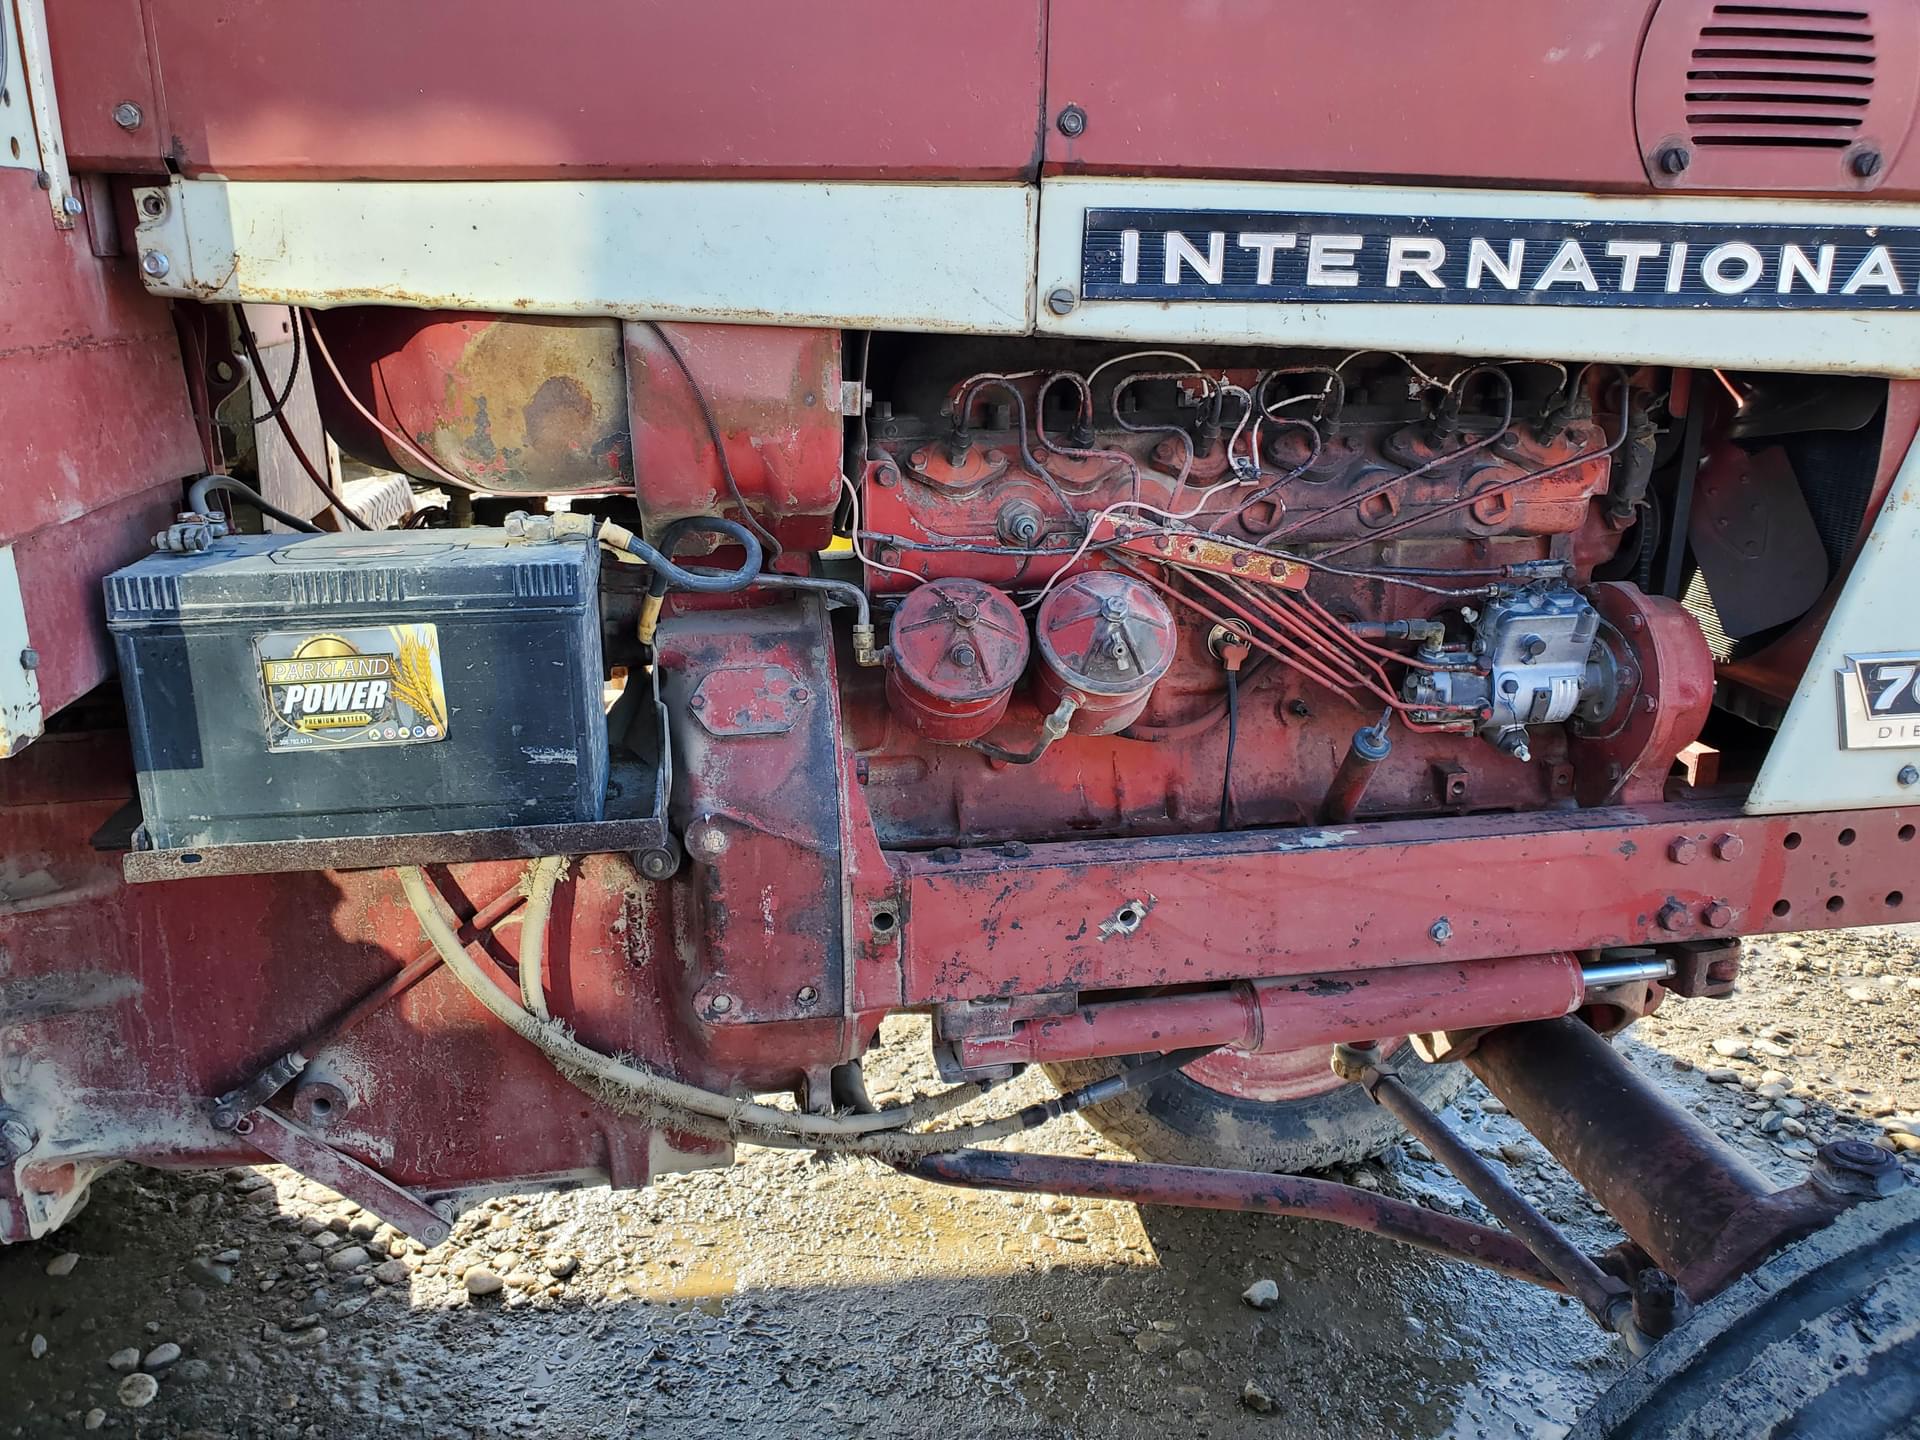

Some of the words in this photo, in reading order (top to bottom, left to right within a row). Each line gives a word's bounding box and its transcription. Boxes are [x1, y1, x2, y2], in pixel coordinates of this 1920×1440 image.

[1120, 228, 1920, 295] INTERNATIONA
[272, 658, 389, 681] PARKLAND
[283, 680, 388, 714] POWER
[1873, 665, 1920, 710] 7
[305, 717, 335, 725] PREMIUM
[337, 715, 367, 723] BATTERY
